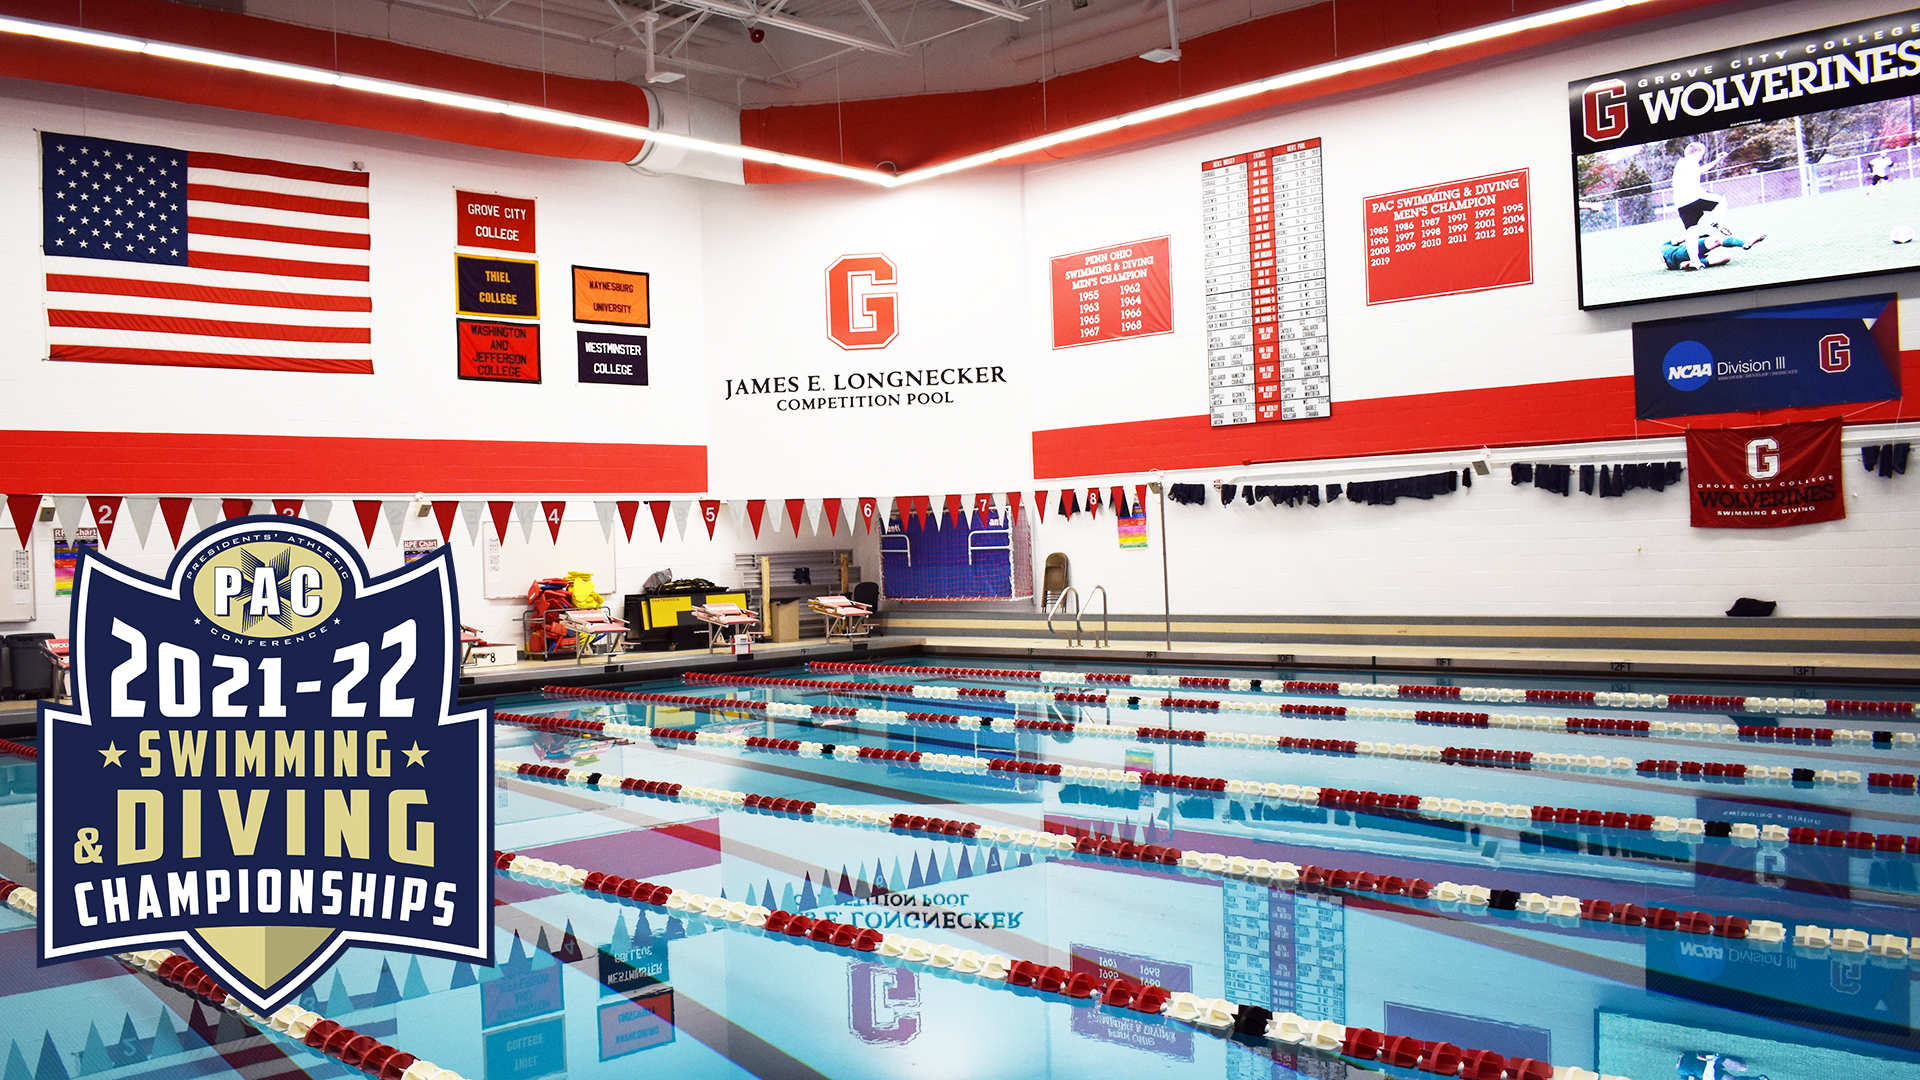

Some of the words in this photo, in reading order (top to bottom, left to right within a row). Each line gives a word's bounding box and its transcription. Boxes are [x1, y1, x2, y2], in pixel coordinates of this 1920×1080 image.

[1638, 65, 1713, 88] GROVE
[1730, 49, 1788, 70] CITY
[1805, 23, 1920, 54] COLLEGE
[1639, 38, 1920, 125] WOLVERINES
[1372, 200, 1394, 213] PAC
[1397, 188, 1460, 208] SWIMMING
[1464, 187, 1471, 196] &
[1475, 178, 1519, 195] DIVING
[468, 204, 500, 217] GROVE
[504, 208, 527, 220] CITY
[1393, 207, 1428, 221] MEN'S
[1431, 194, 1496, 214] CHAMPION
[1370, 226, 1388, 236] 1985
[1395, 222, 1414, 232] 1986
[1421, 217, 1440, 227] 1987
[1448, 213, 1466, 223] 1991
[1475, 208, 1495, 219] 1992
[1502, 203, 1523, 214] 1995
[475, 226, 519, 241] COLLEGE
[1370, 236, 1389, 246] 1996
[1395, 232, 1414, 242] 1997
[1421, 228, 1441, 238] 1998
[1448, 223, 1468, 233] 1999
[1475, 219, 1495, 229] 2001
[1502, 214, 1525, 225] 2004
[1370, 246, 1390, 256] 2008
[1395, 242, 1416, 252] 2009
[1421, 238, 1441, 248] 2010
[1448, 234, 1467, 244] 2011
[1475, 230, 1495, 240] 2012
[1503, 225, 1524, 236] 2014
[1085, 253, 1107, 265] PENN
[1110, 249, 1132, 260] OHIO
[1371, 257, 1390, 267] 2019
[1065, 264, 1111, 280] SWIMMING
[1114, 263, 1120, 271] &
[1122, 256, 1154, 270] DIVING
[485, 271, 510, 283] THIEL
[1072, 278, 1097, 290] MEN'S
[1099, 268, 1147, 284] CHAMPION
[589, 281, 634, 293] WAYNESBURG
[1079, 290, 1099, 302] 1955
[1120, 283, 1140, 295] 1962
[479, 292, 517, 305] COLLEGE
[825, 252, 899, 351] G
[1079, 302, 1099, 314] 1963
[1120, 295, 1141, 307] 1964
[593, 303, 631, 313] UNIVERSITY
[1080, 314, 1100, 326] 1965
[1121, 308, 1141, 319] 1966
[471, 325, 527, 339] WASHINGTON
[1080, 326, 1099, 338] 1967
[1121, 320, 1142, 331] 1968
[490, 340, 509, 351] AND
[585, 342, 642, 356] WESTMINSTER
[1819, 333, 1851, 374] G
[472, 352, 527, 364] JEFFERSON
[477, 365, 521, 377] COLLEGE
[594, 363, 633, 375] COLLEGE
[1668, 363, 1712, 381] NCAA
[1717, 359, 1771, 375] Division
[1776, 356, 1785, 369] III
[725, 376, 799, 400] JAMES
[808, 375, 825, 392] E.
[834, 366, 1007, 391] LONGNECKER
[777, 394, 900, 411] COMPETITION
[907, 391, 954, 406] POOL
[1745, 436, 1780, 480] G
[1780, 475, 1833, 486] COLLEGE
[1090, 493, 1097, 505] 8
[1698, 483, 1835, 508] WOLVERINES
[864, 503, 872, 517] 6
[980, 499, 987, 511] 7
[1782, 506, 1815, 514] DIVING
[98, 505, 112, 523] 2
[549, 509, 559, 524] 4
[706, 507, 715, 521] 5
[490, 652, 495, 663] 8
[1611, 662, 1632, 671] 12FT
[1793, 666, 1816, 676] 13FT
